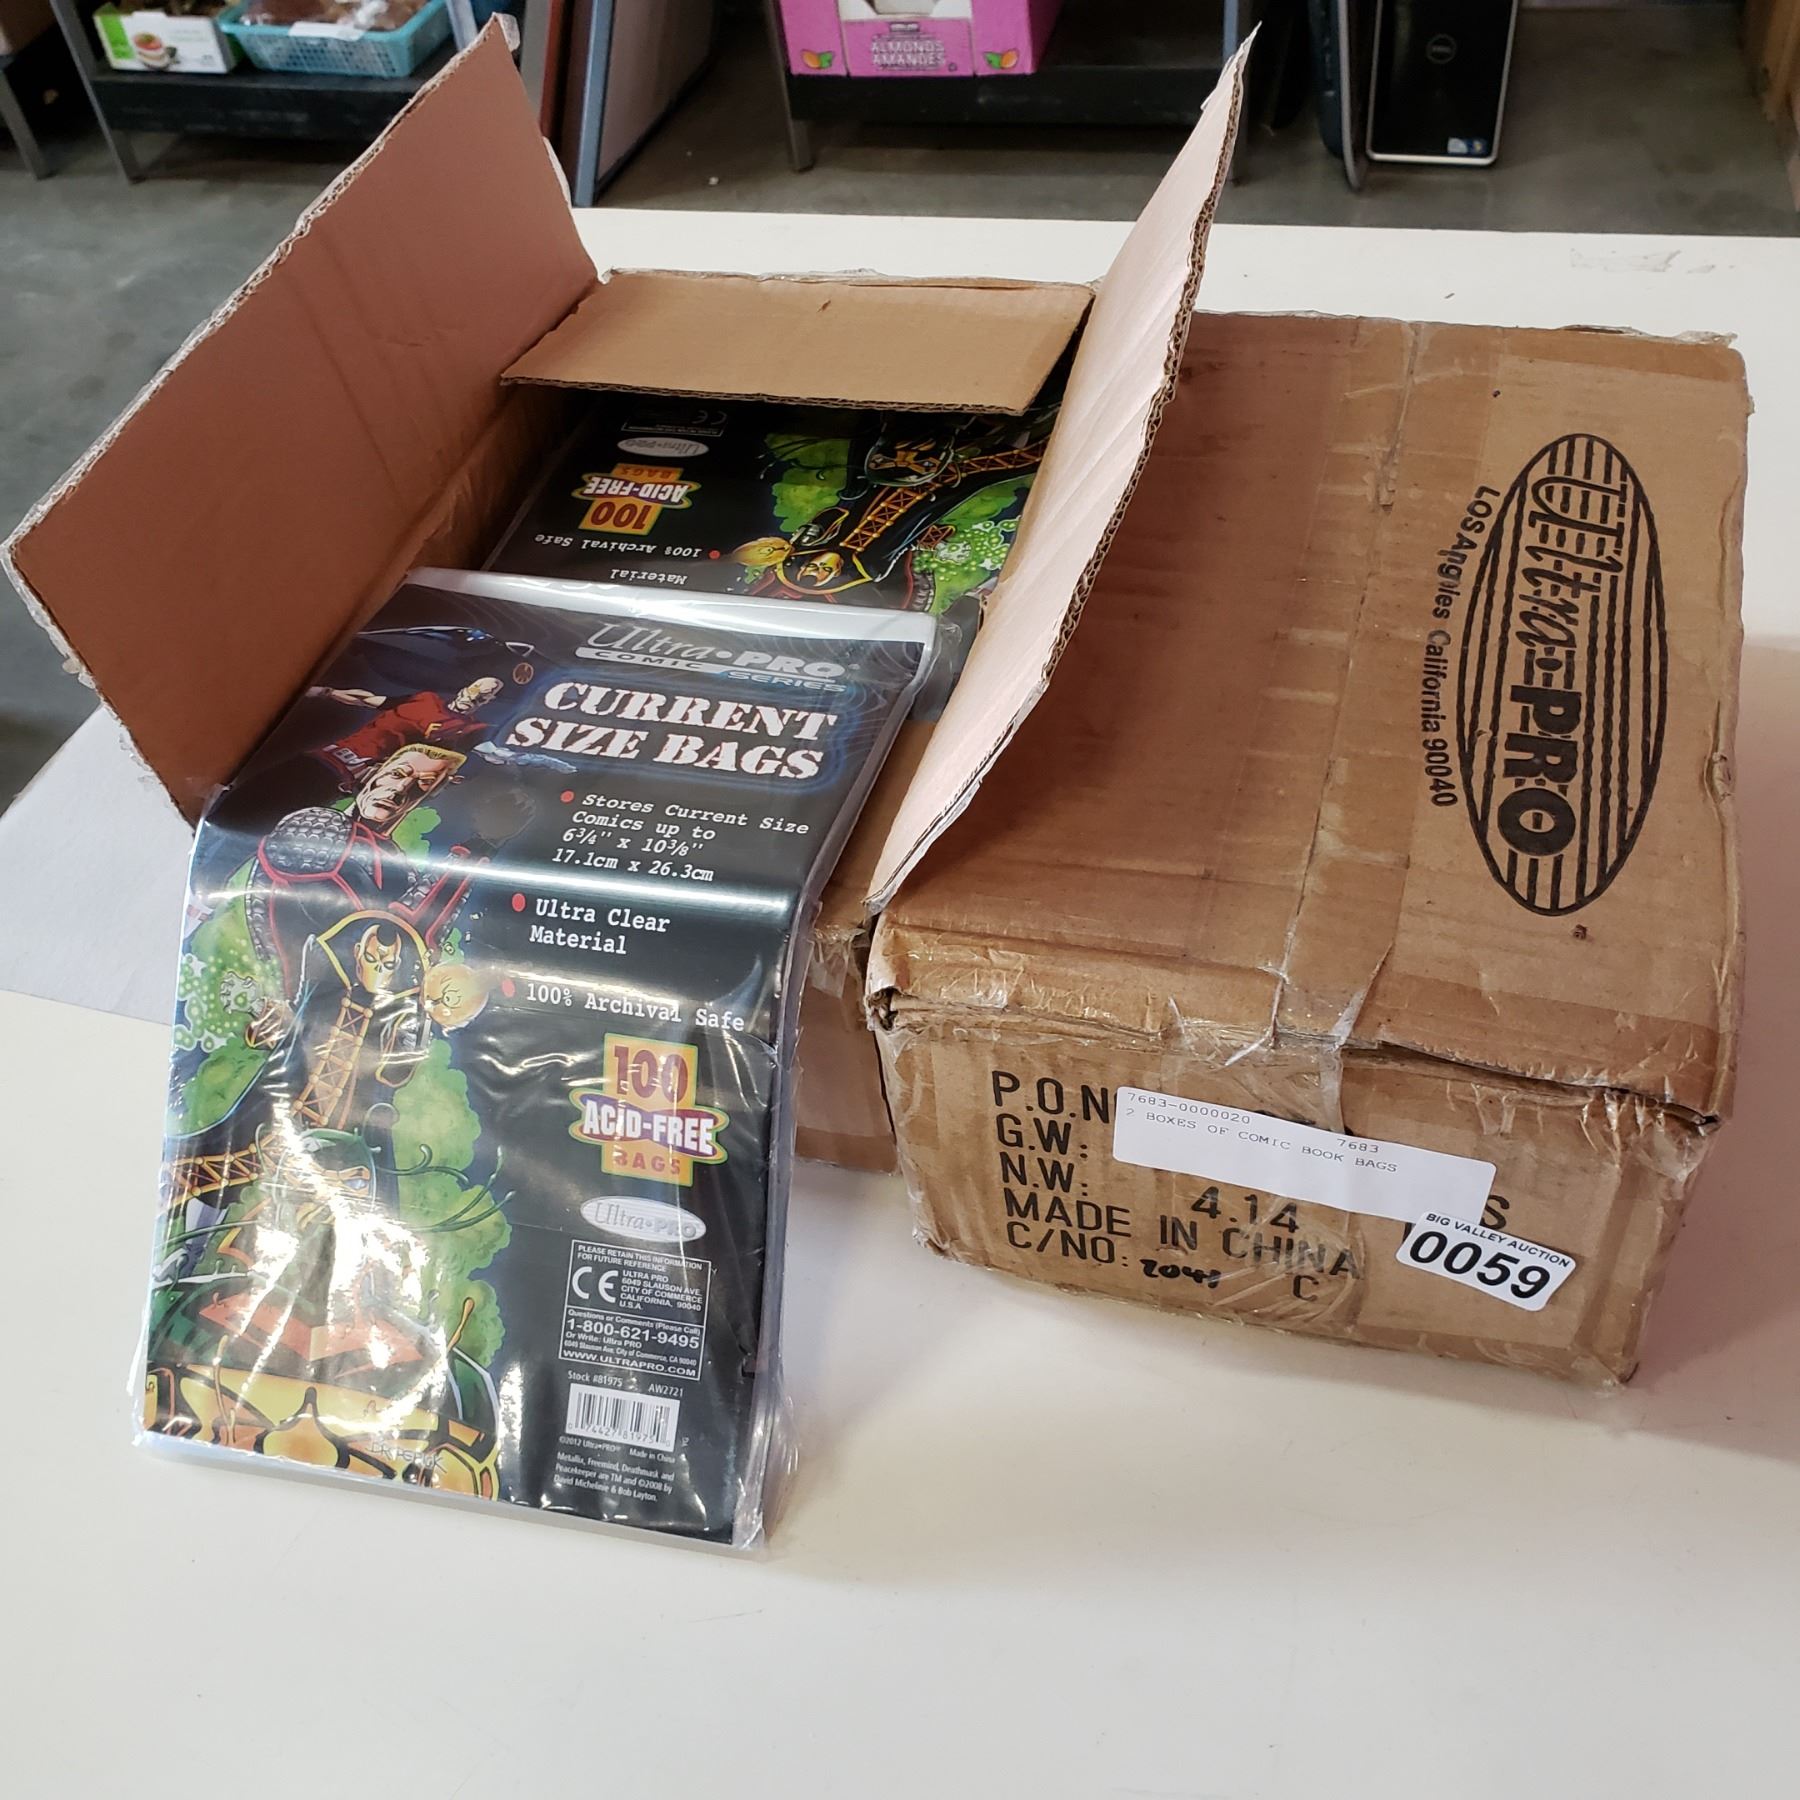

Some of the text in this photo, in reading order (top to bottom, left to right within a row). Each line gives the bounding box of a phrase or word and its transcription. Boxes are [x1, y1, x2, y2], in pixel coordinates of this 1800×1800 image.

[583, 477, 690, 503] ACID-FREE
[590, 502, 652, 530] 100
[535, 534, 703, 559] 100% Archival Safe
[610, 569, 688, 585] Material
[727, 671, 847, 692] SERIES
[1421, 630, 1451, 733] California
[544, 682, 838, 740] CURRENT
[505, 718, 824, 779] SIZE BAGS
[1423, 738, 1458, 807] 90040
[572, 811, 716, 841] Comics up to
[582, 793, 810, 835] Stores Current Size
[617, 837, 631, 850] x
[552, 848, 715, 882] 17.1cm x 26.3cm
[535, 898, 670, 933] Ultra Clear
[530, 925, 627, 955] Material
[526, 983, 745, 1032] 100% Archival Safe
[614, 1045, 688, 1104] 100
[992, 1070, 1117, 1124] P.O.N
[1127, 1092, 1251, 1125] 7683-0000020
[582, 1100, 715, 1157] ACID-FREE
[1146, 1112, 1196, 1130] BOXES
[1207, 1124, 1229, 1136] OF
[1238, 1131, 1291, 1151] COMIC
[1301, 1145, 1345, 1163] BOOK
[1355, 1157, 1398, 1174] BAGS
[1337, 1138, 1380, 1154] 7683
[613, 1149, 681, 1176] BAGS
[1191, 1186, 1299, 1234] 4.14
[1004, 1187, 1358, 1281] MADE IN CHINA
[1426, 1212, 1572, 1269] BIG VALLEY AUCTION
[577, 1252, 667, 1273] FOR FUTURE REFERENCE
[578, 1244, 703, 1270] PLEASE RETAIN THIS INFORMATION
[1408, 1230, 1551, 1301] 0059
[622, 1270, 669, 1283] ULTRA PRO
[642, 1280, 682, 1293] SLAUSON
[621, 1285, 703, 1303] CITY OF COMMERCE
[676, 1302, 702, 1311] 90040
[567, 1318, 700, 1349] 1-800-621-9495
[568, 1310, 604, 1321] Questions
[615, 1316, 654, 1328] Comments
[655, 1320, 683, 1332] (Please
[684, 1325, 701, 1336] Call)
[566, 1331, 577, 1339] Or
[603, 1337, 623, 1347] Ultra
[624, 1340, 642, 1349] PRO
[563, 1349, 696, 1377] WWW.ULTRAPRO.COM
[567, 1370, 623, 1387] Stock #81975
